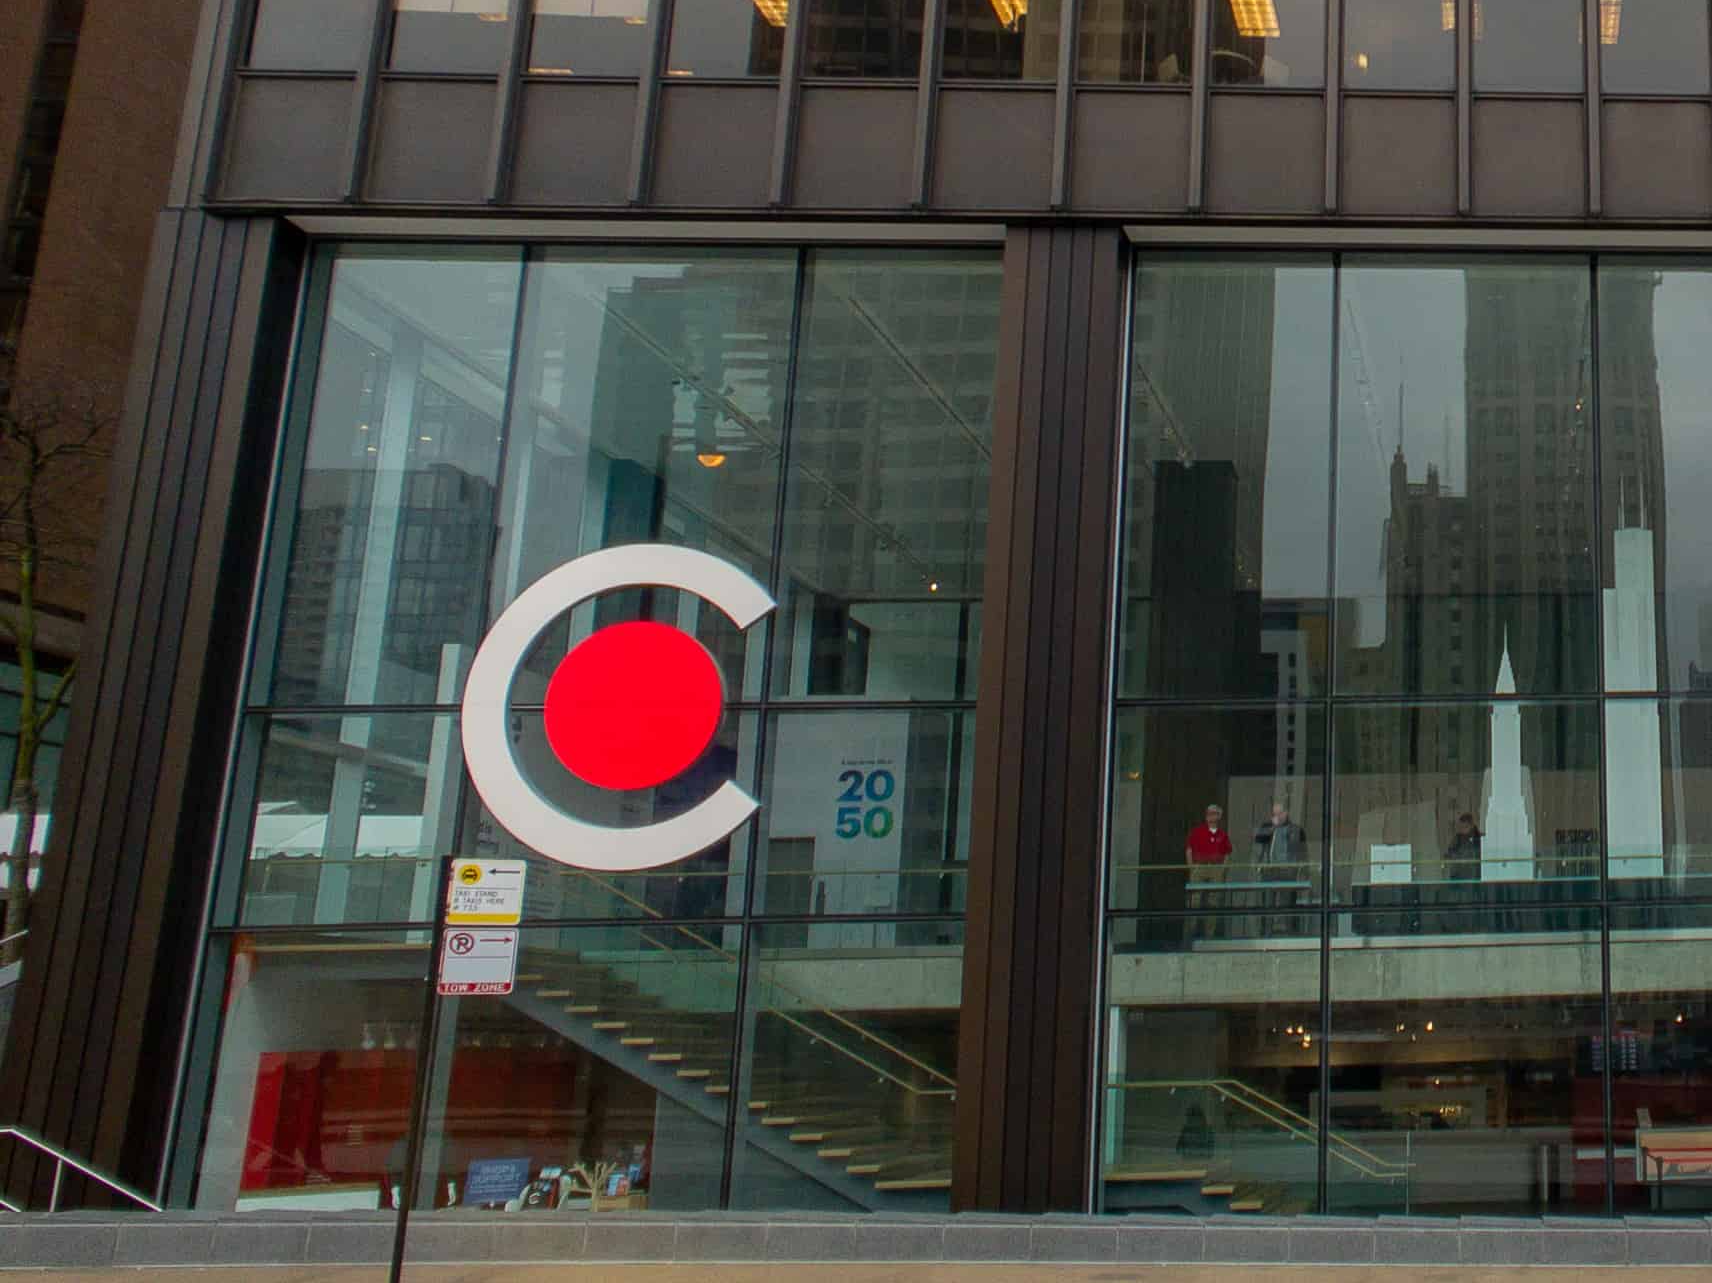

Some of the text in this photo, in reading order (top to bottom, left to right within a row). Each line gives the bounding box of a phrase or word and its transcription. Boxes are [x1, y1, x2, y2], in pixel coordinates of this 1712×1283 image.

[836, 769, 895, 802] 20
[835, 806, 894, 839] 50
[443, 983, 505, 993] TOW ZONE
